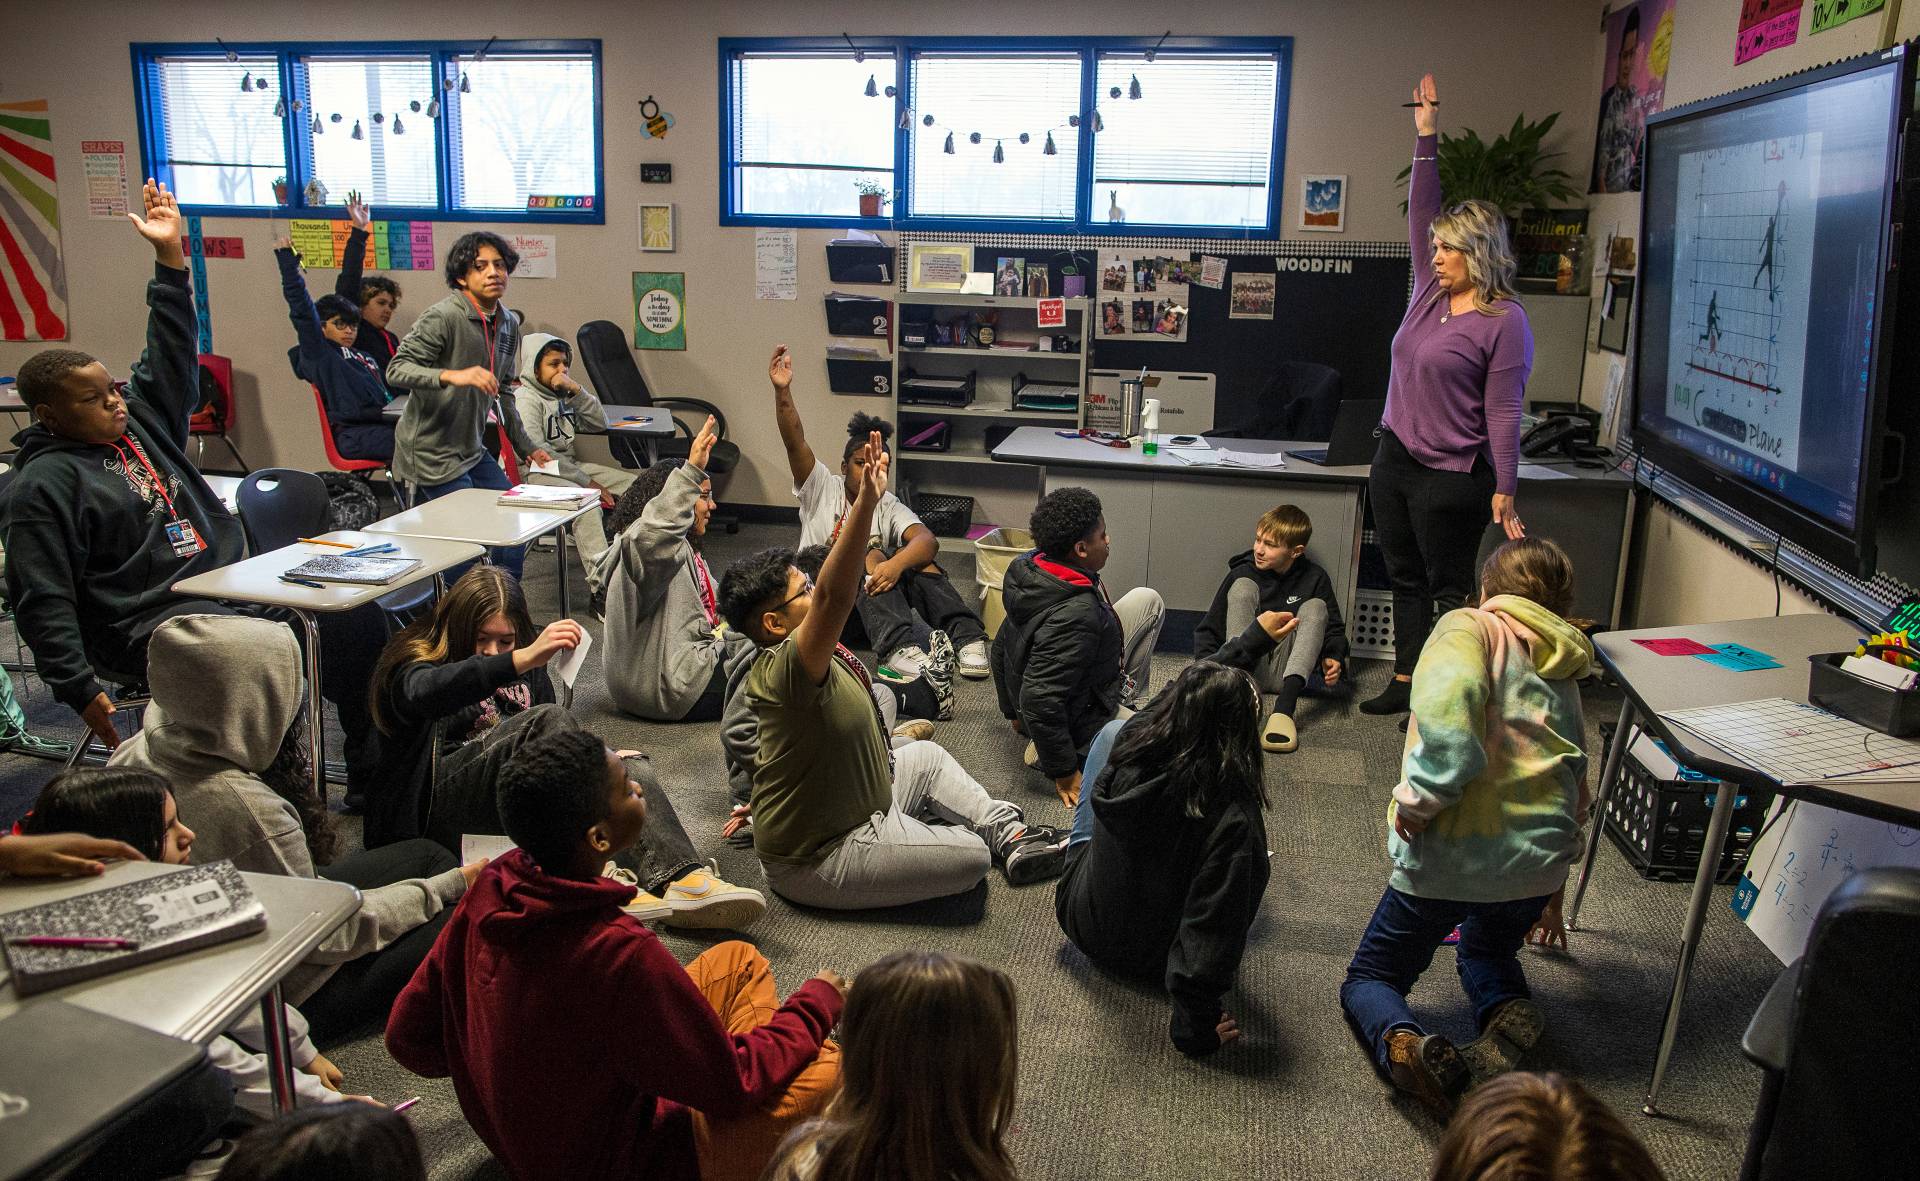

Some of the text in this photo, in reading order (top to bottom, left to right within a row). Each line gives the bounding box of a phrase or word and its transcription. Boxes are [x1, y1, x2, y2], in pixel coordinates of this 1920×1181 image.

[1812, 3, 1824, 29] 10
[1736, 34, 1745, 62] 5
[83, 142, 122, 153] SHAPES
[292, 221, 330, 231] Thousands
[877, 263, 891, 283] 1
[1275, 257, 1353, 274] WOODFIN
[191, 218, 209, 354] COLUMNS
[650, 294, 669, 304] Today
[657, 303, 671, 312] day
[872, 315, 888, 335] 2
[873, 375, 890, 393] 3
[1089, 394, 1106, 404] 3M
[1749, 423, 1782, 458] Plane
